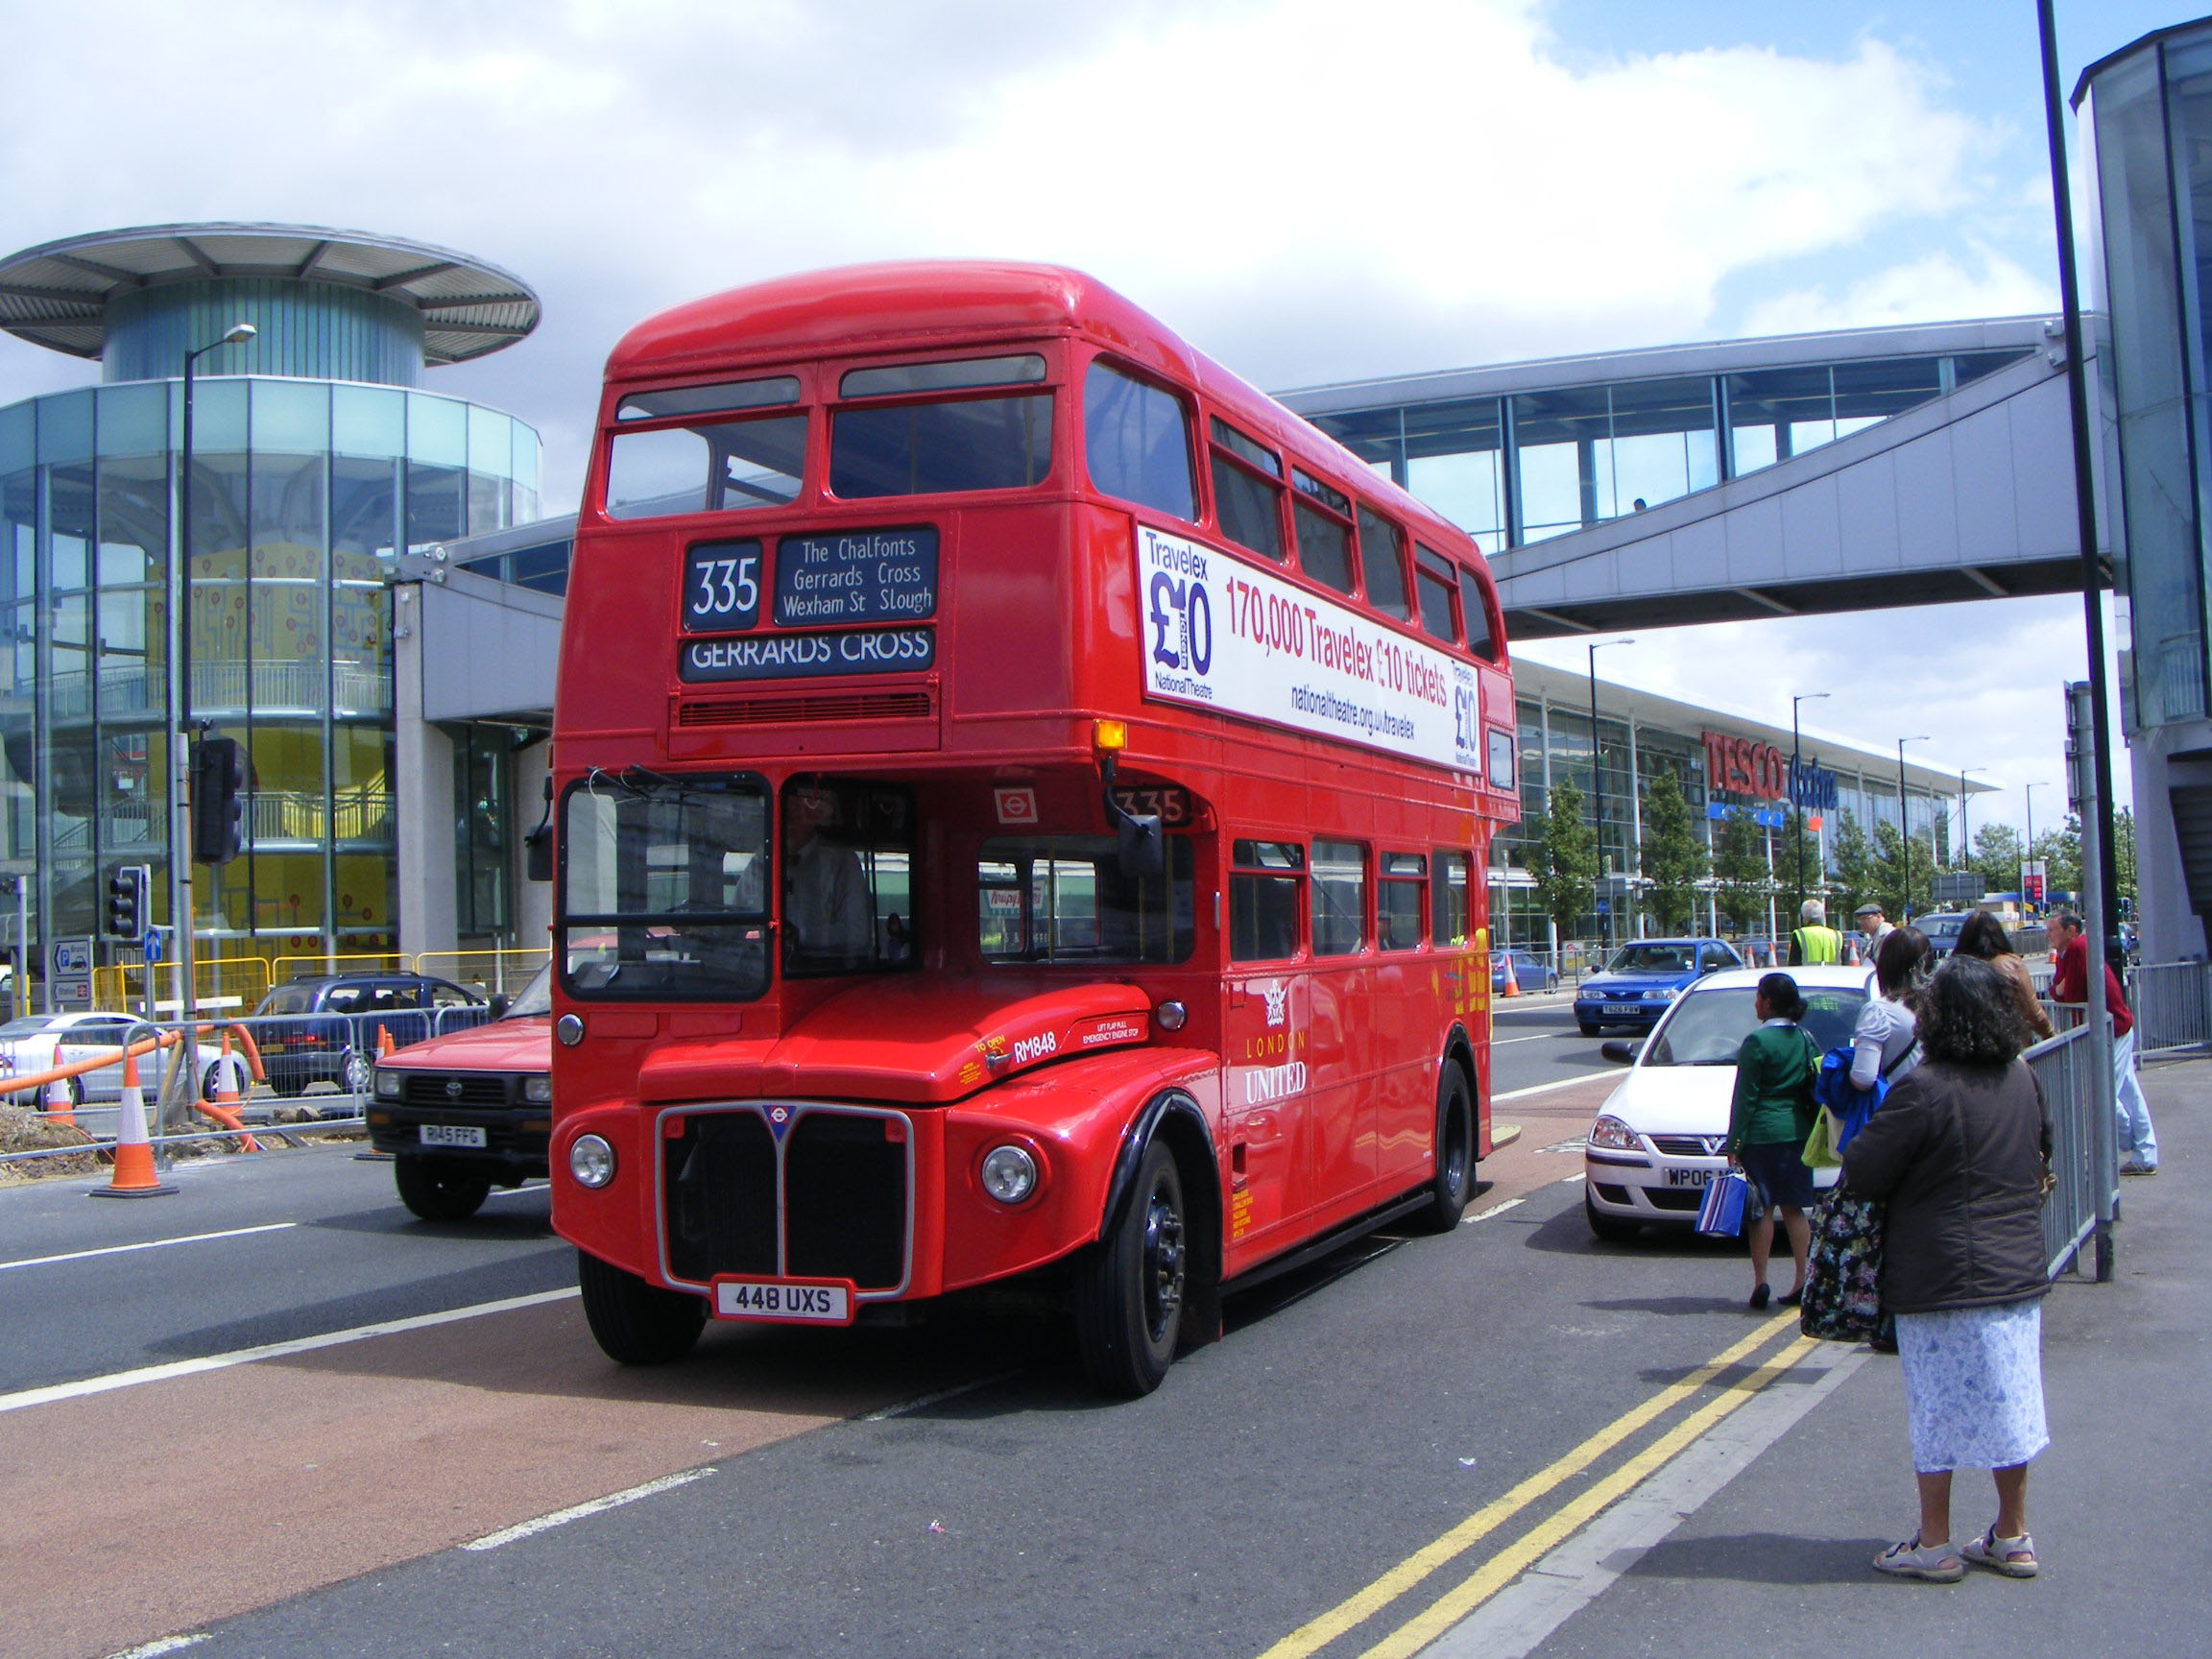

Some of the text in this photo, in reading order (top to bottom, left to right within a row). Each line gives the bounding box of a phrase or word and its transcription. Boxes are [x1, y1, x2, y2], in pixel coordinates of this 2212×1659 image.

[802, 536, 916, 565] The Chalfonts
[1145, 531, 1209, 581] Travelex
[692, 556, 758, 615] 335
[794, 563, 921, 591] Gerrards Cross
[782, 586, 932, 617] Wexham St Slough
[691, 630, 929, 670] GERRARDS CROSS
[1226, 576, 1448, 708] 170,000 Travelex £10 tickets
[1701, 731, 1784, 802] TESCO
[1117, 789, 1183, 823] 335
[974, 1034, 1006, 1053] TO OPEN
[1013, 1031, 1057, 1064] RM848
[1082, 1027, 1139, 1045] EMERGENCY ENGINE STOP
[1246, 1030, 1306, 1059] LONDON
[1244, 1061, 1307, 1104] UNITED
[1669, 1168, 1713, 1187] WP06
[735, 1286, 831, 1313] 448 UXS
